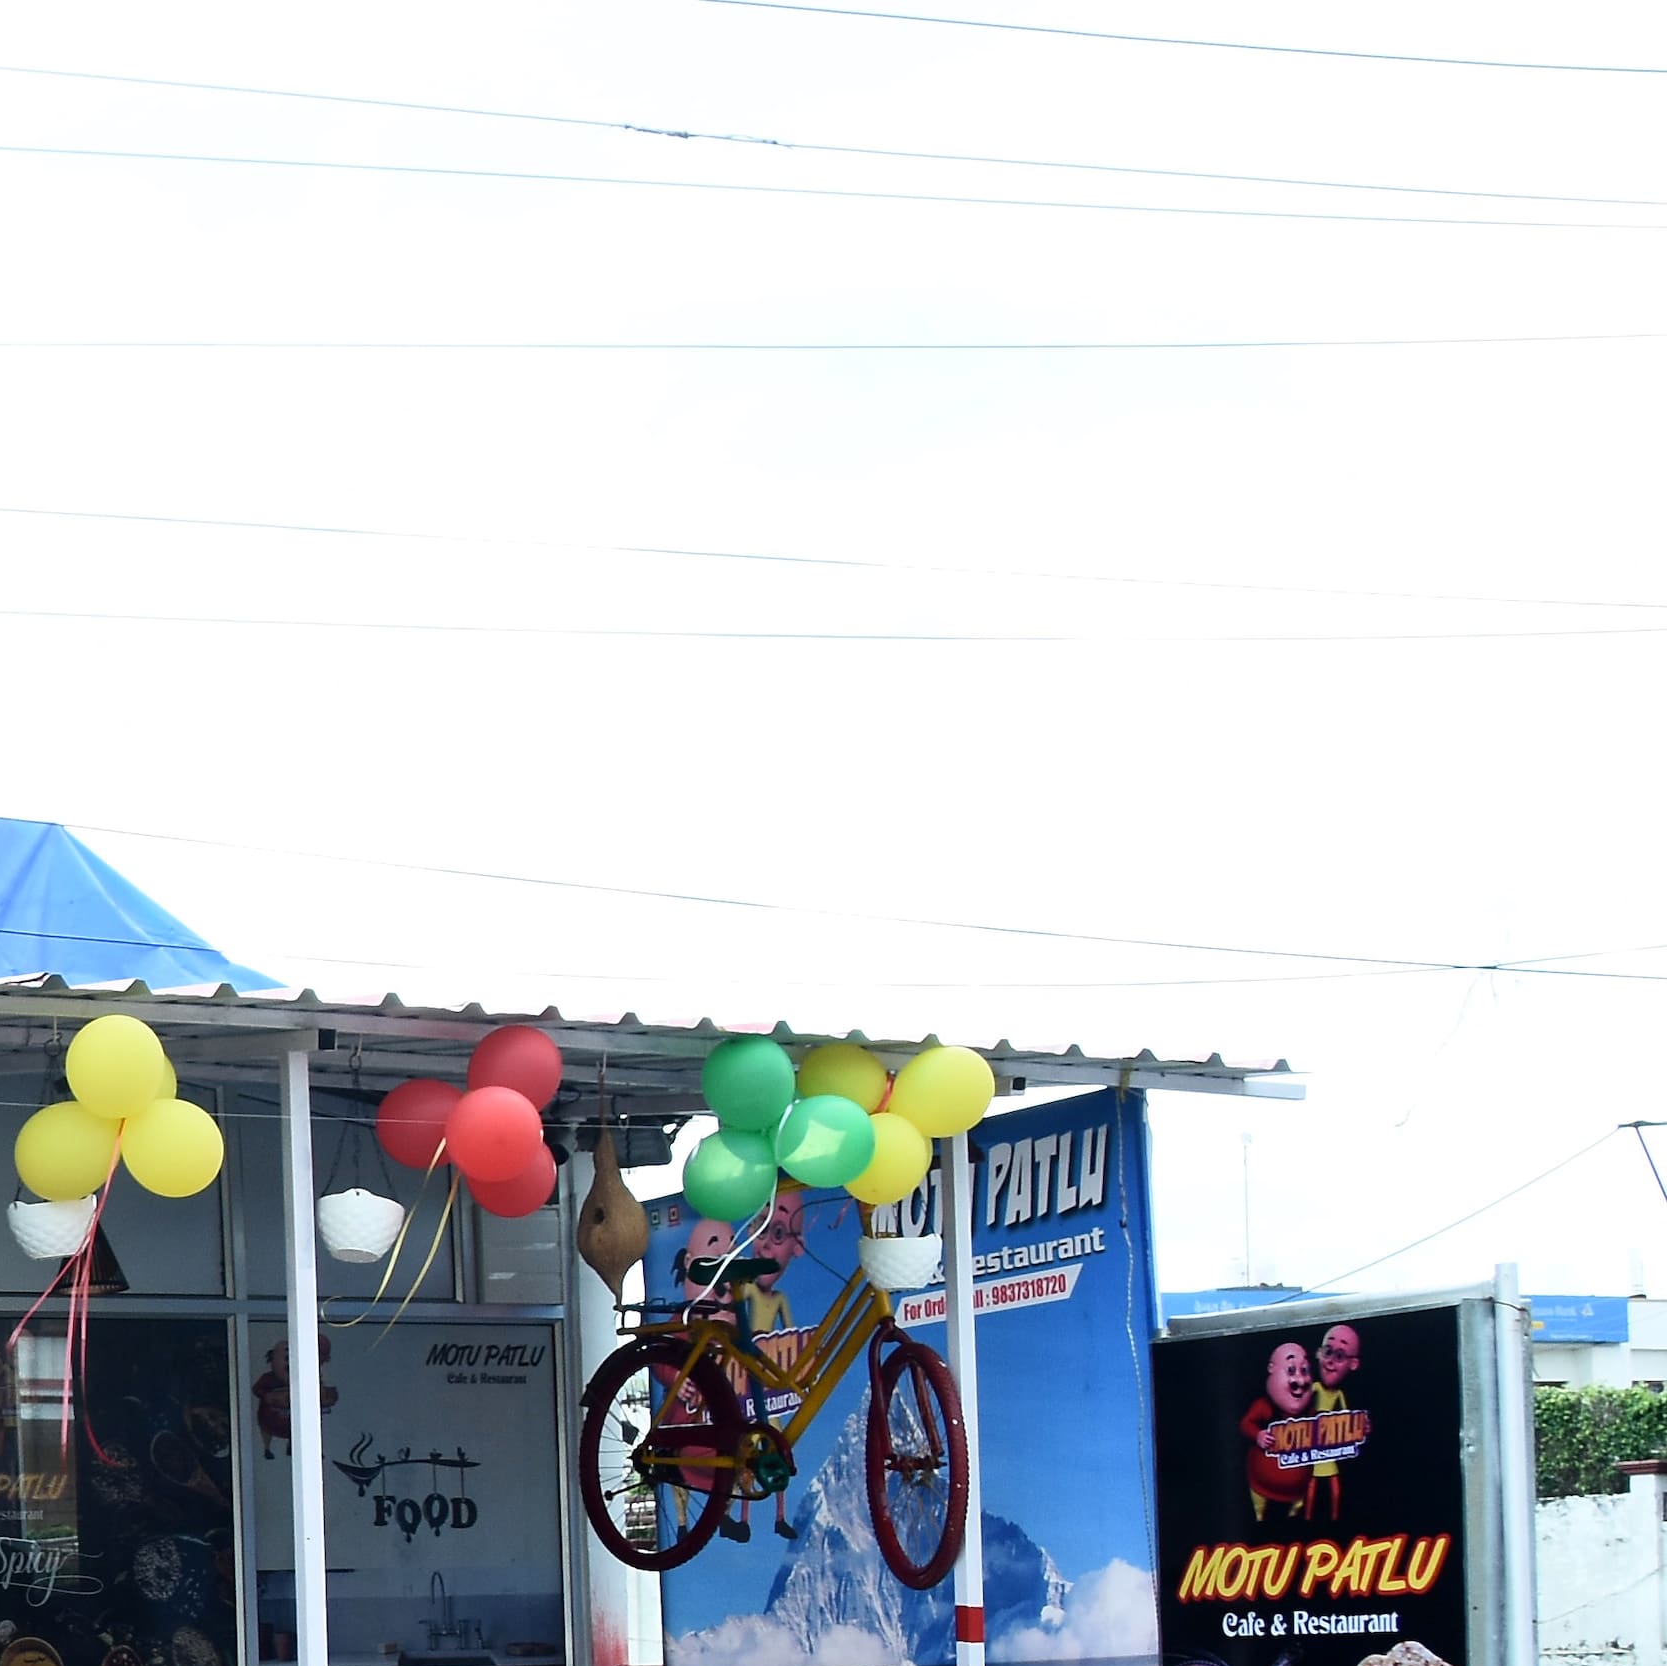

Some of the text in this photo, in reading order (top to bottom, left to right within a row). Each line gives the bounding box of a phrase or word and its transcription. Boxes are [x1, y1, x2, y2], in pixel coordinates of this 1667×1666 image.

[986, 1124, 1108, 1227] PATLU
[972, 1226, 1106, 1276] estaurant
[903, 1297, 922, 1322] For
[992, 1273, 1067, 1306] 9837318720
[426, 1343, 547, 1368] MOTU PATLU
[1270, 1411, 1367, 1452] MOTU PATLU
[1280, 1452, 1300, 1466] Cafe
[1301, 1452, 1310, 1463] &
[373, 1494, 478, 1541] FOOD
[1177, 1533, 1451, 1602] MOTU PATLU
[1222, 1610, 1399, 1637] Cafe & Restaurant
